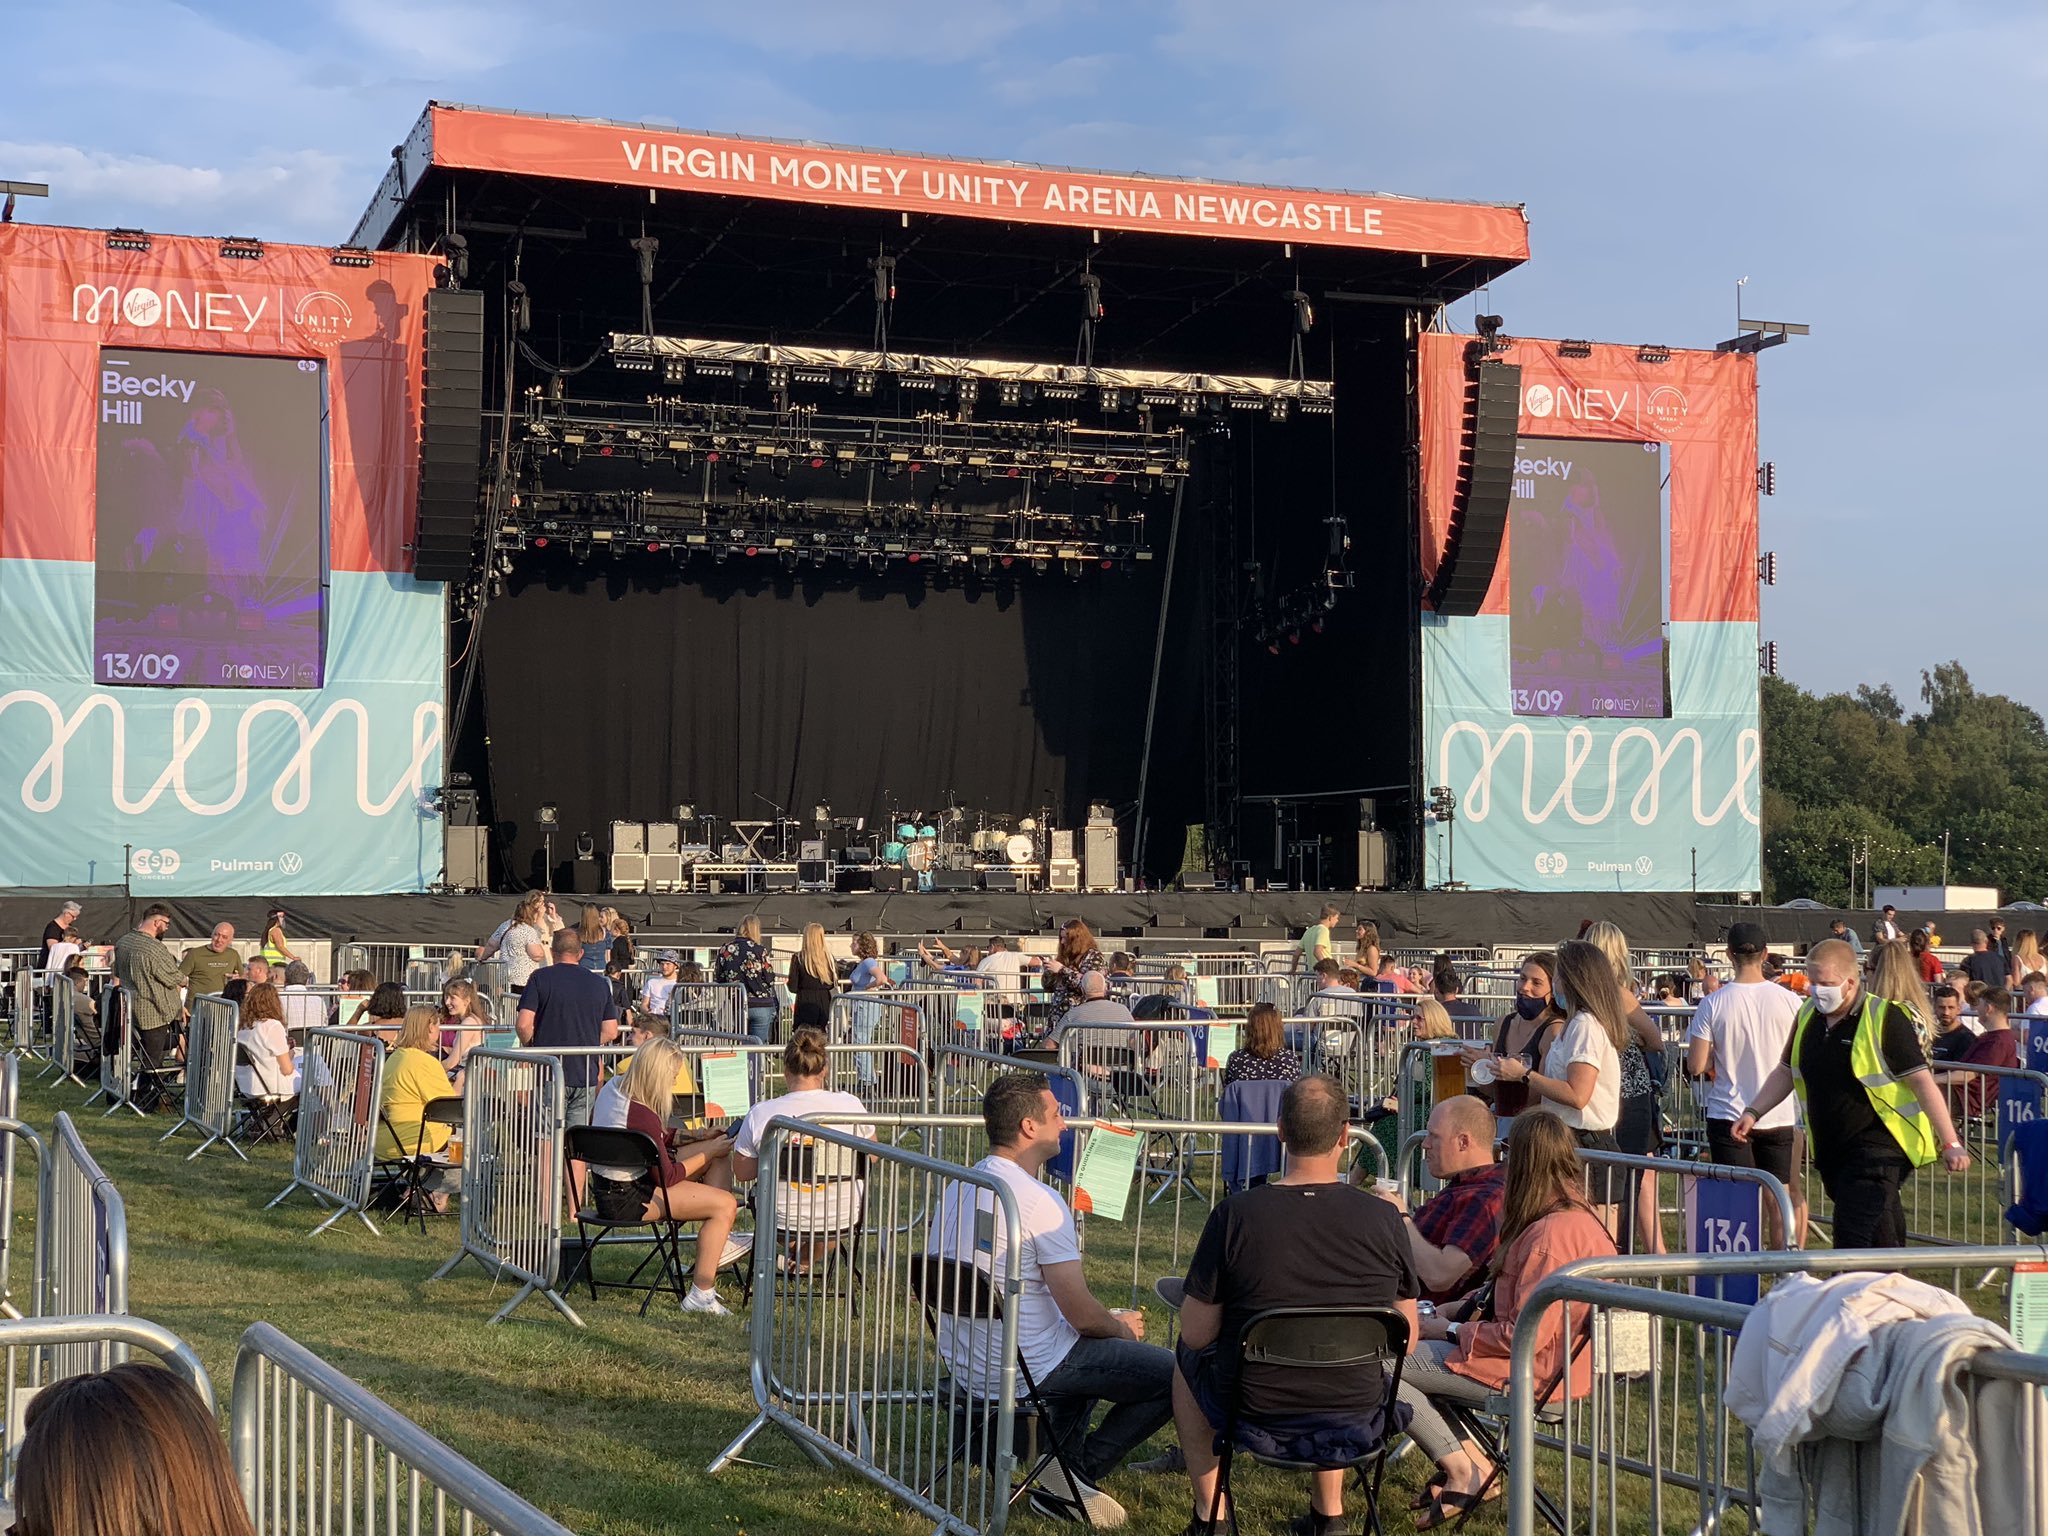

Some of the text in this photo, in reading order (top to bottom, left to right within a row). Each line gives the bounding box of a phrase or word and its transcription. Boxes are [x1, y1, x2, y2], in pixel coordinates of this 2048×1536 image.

[621, 139, 1384, 236] VIRGIN MONEY UNITY ARENA NEWCASTLE
[295, 313, 353, 329] UNITY
[102, 370, 196, 403] Becky
[102, 399, 143, 425] Hill
[1519, 383, 1629, 422] ONEY
[1647, 405, 1688, 417] UNITY
[102, 653, 180, 680] 13/09
[1511, 689, 1564, 712] 13/09
[210, 858, 274, 872] Pulman
[1587, 860, 1632, 872] Pulman
[2006, 1099, 2034, 1124] 116
[1081, 1138, 1098, 1172] GUIDELINES
[1704, 1217, 1751, 1252] 136
